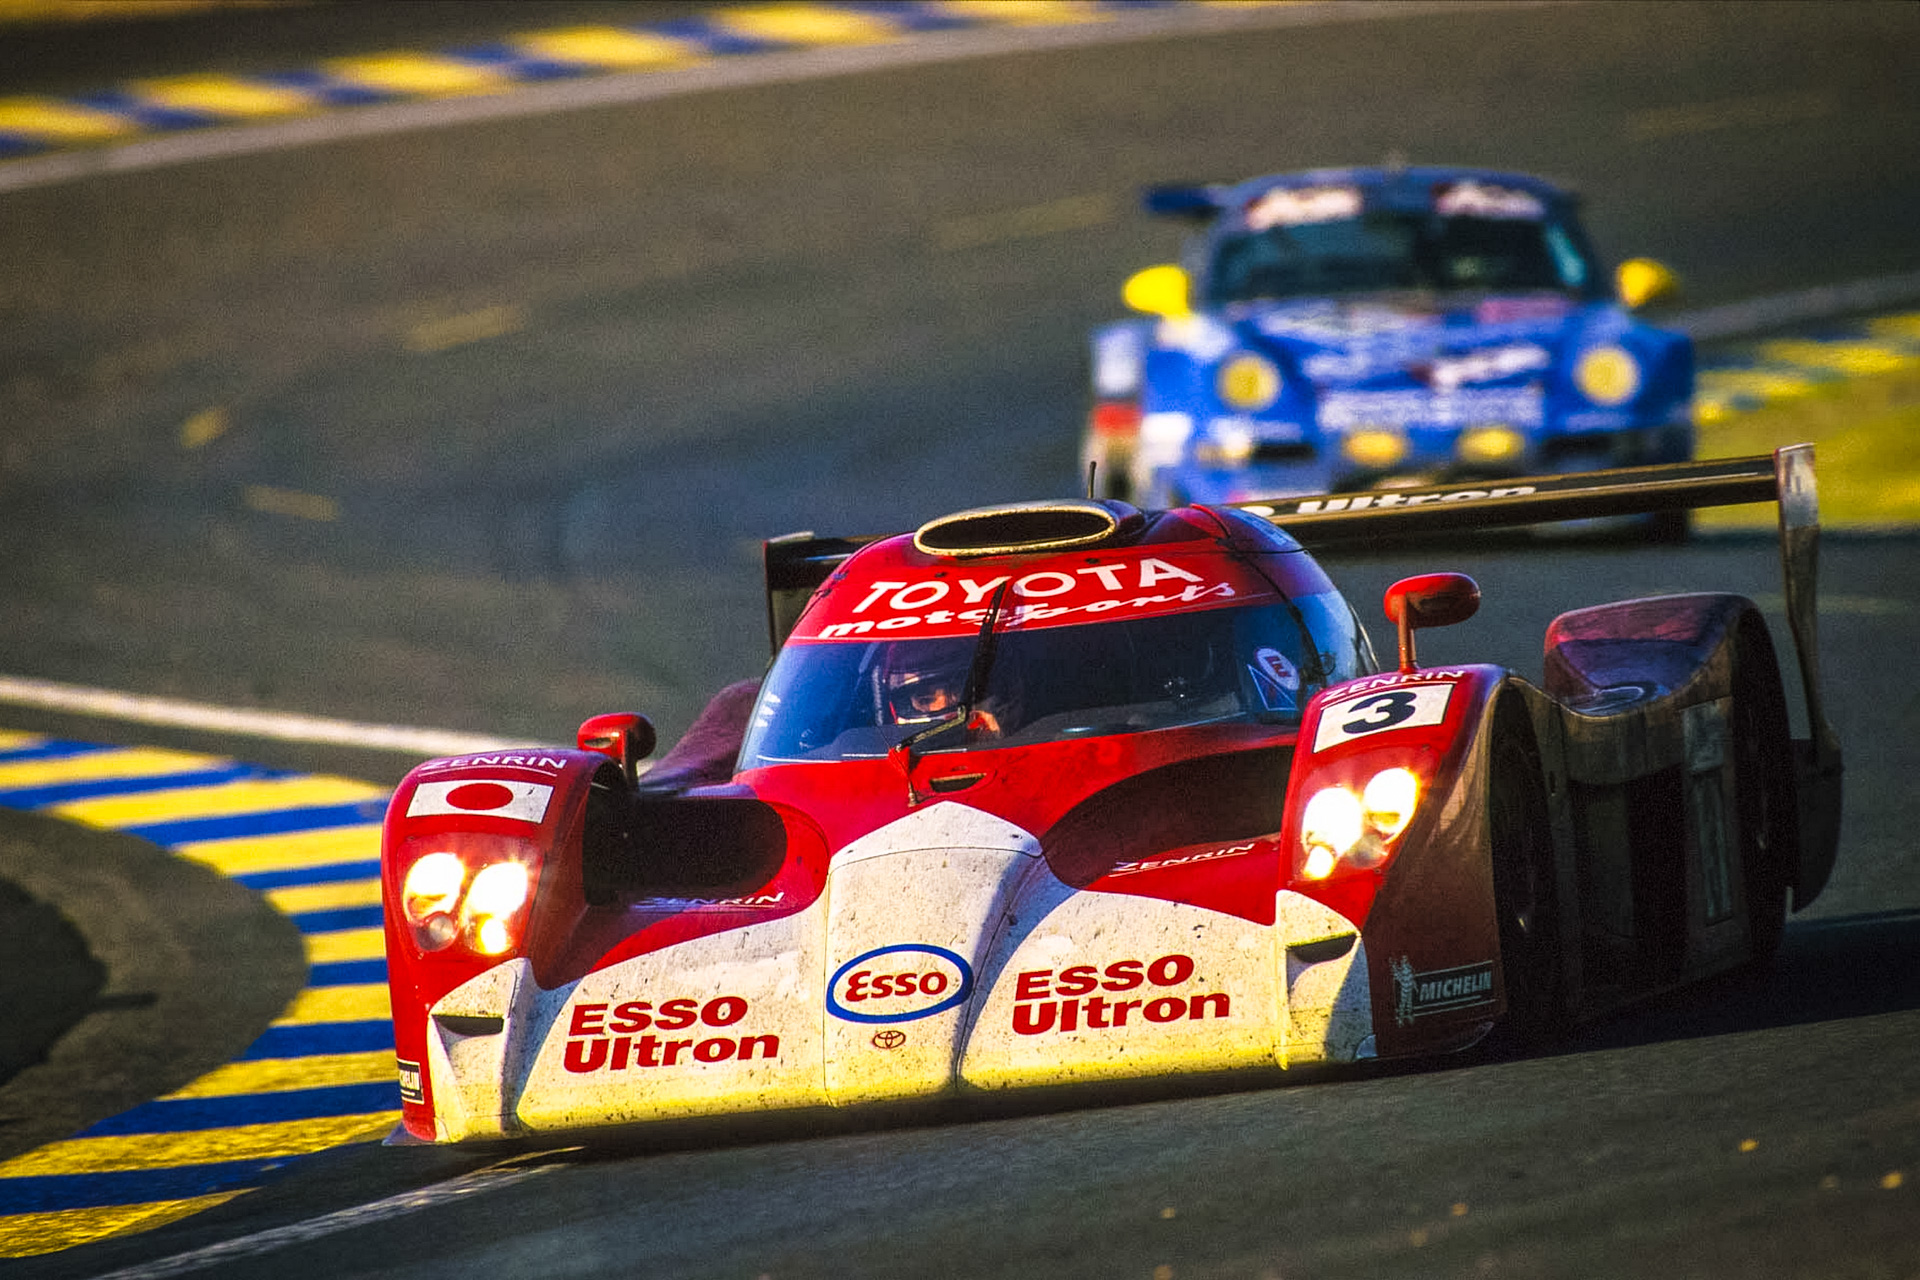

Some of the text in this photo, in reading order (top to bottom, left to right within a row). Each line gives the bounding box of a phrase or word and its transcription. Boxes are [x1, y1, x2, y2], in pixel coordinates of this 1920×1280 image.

[1297, 486, 1536, 513] Ultron
[852, 558, 1203, 613] TOYOTA
[1321, 670, 1465, 703] ZENRIN
[1342, 691, 1417, 734] 3
[420, 755, 568, 771] ZENRIN
[1112, 842, 1255, 872] ZENRIN
[1419, 970, 1493, 1001] MICHELIN
[1012, 992, 1231, 1036] Ultron
[563, 1035, 780, 1073] Ultron
